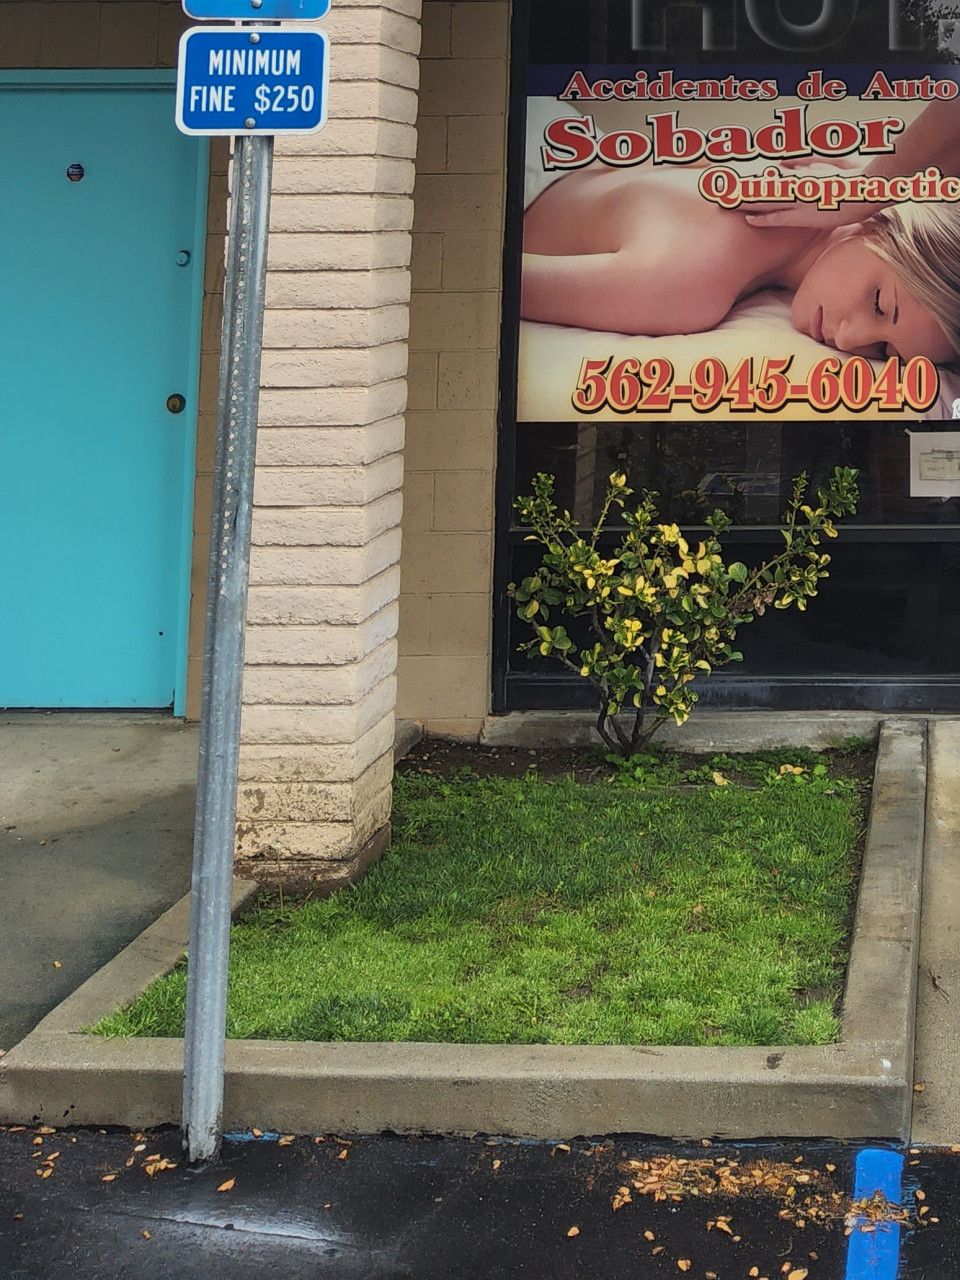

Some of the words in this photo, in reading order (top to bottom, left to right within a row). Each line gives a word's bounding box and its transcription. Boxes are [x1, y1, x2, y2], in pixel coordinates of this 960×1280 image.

[209, 49, 301, 76] MINIMUM
[190, 85, 236, 112] FINE
[254, 83, 315, 115] $250
[557, 70, 779, 101] Accidentes
[796, 70, 849, 101] de
[860, 70, 960, 101] Auto
[543, 104, 905, 171] Sobador
[571, 354, 940, 414] 562-945-6040
